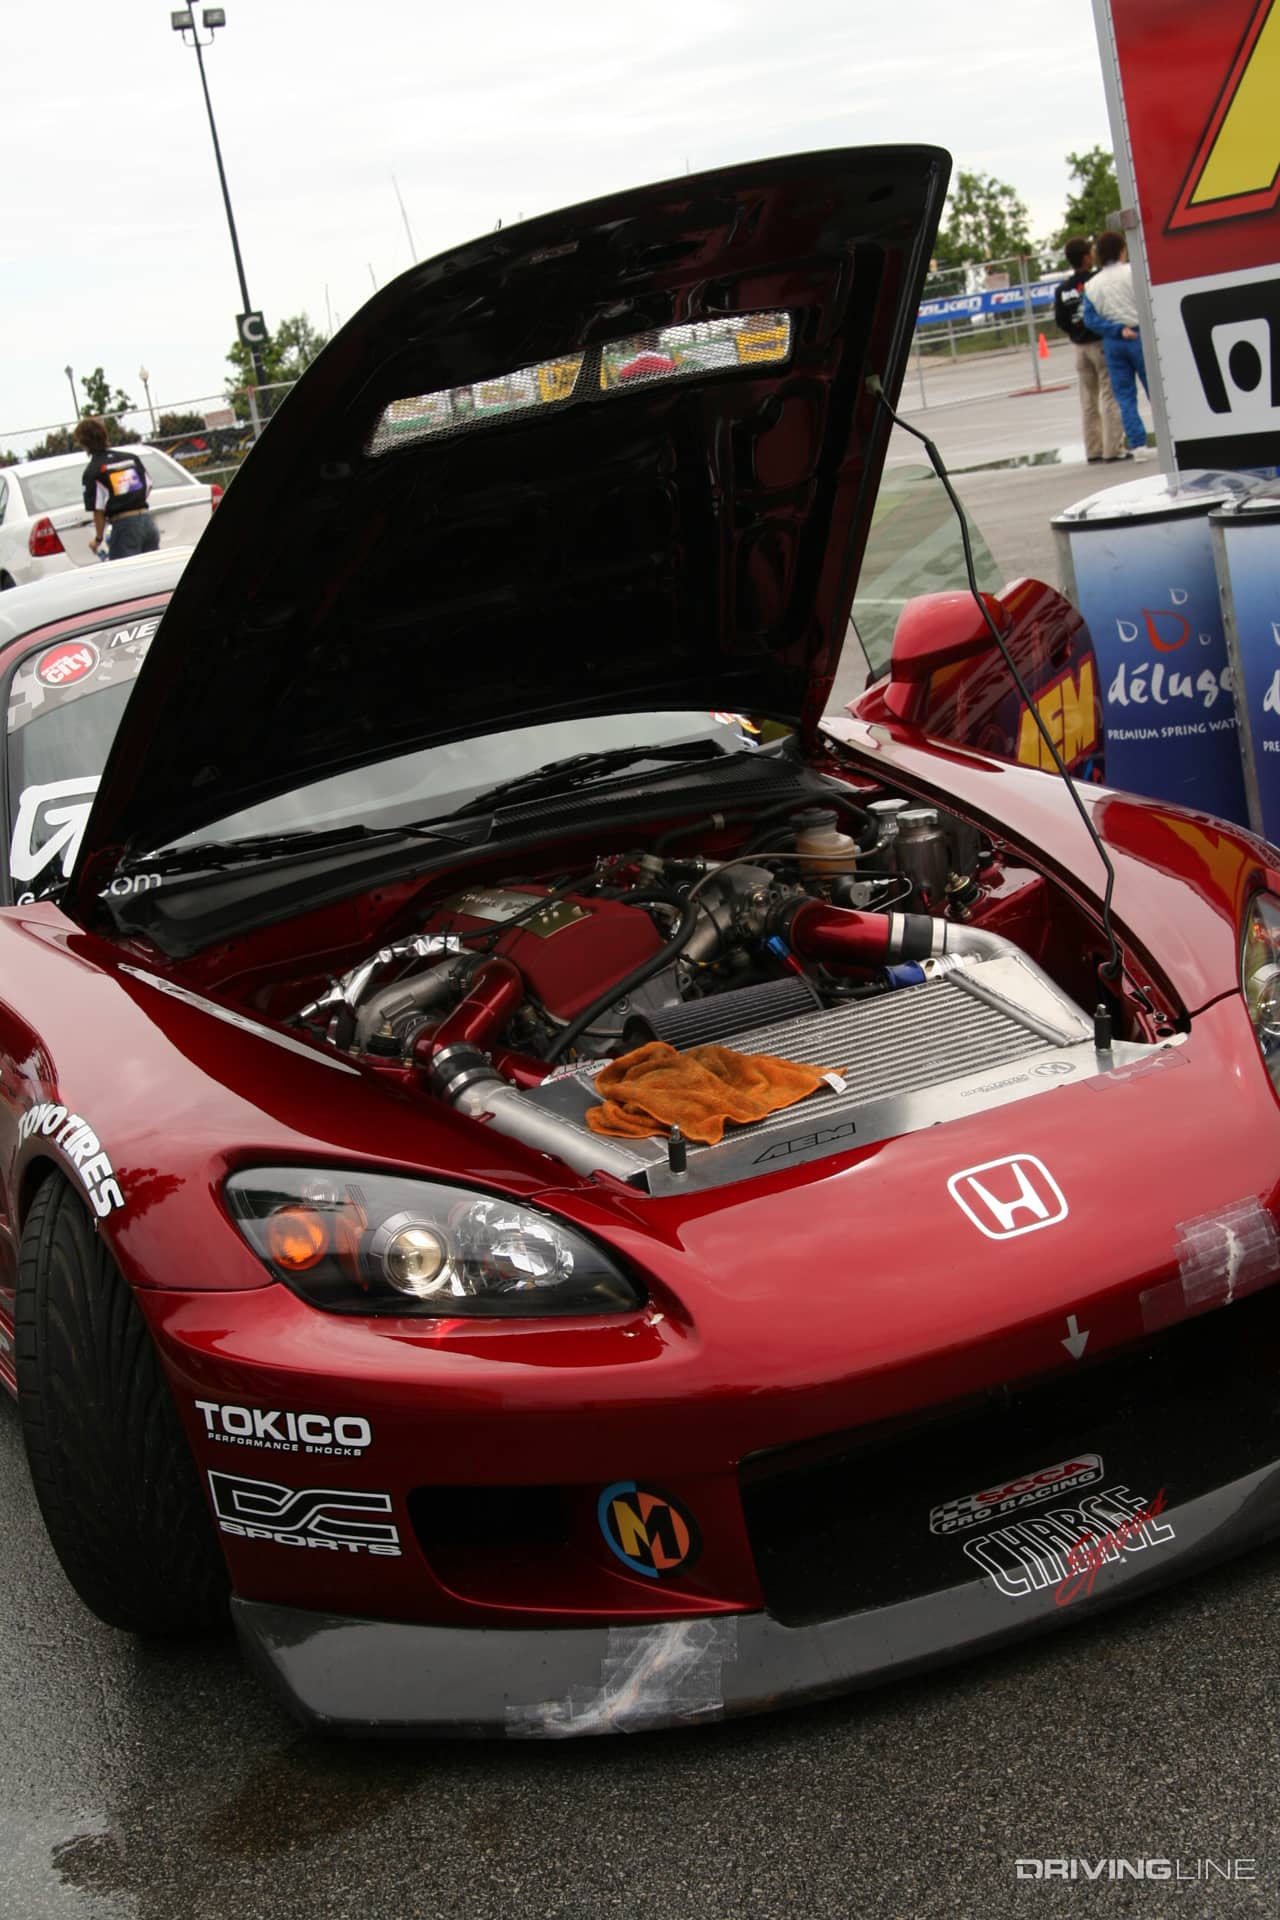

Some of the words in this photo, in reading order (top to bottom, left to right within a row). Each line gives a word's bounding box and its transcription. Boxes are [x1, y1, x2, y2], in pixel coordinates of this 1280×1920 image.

[918, 296, 982, 317] ALKEN
[242, 316, 264, 341] C
[46, 648, 93, 683] city
[1107, 728, 1160, 741] PREMIUM
[1161, 721, 1207, 738] SPRING
[1208, 711, 1241, 733] WAT
[17, 1103, 68, 1149] TOYO
[752, 1122, 857, 1165] AEM
[55, 1113, 126, 1218] TIRES
[195, 1400, 372, 1447] TOKICO
[207, 1432, 300, 1452] PERFORMANCE
[305, 1444, 363, 1457] SHOCKS
[941, 1508, 991, 1533] PRO
[1000, 1471, 1095, 1511] RACING
[976, 1461, 1094, 1504] SCCA
[207, 1470, 400, 1543] DC
[219, 1521, 403, 1557] SPORTS
[963, 1485, 1175, 1596] CHARGE
